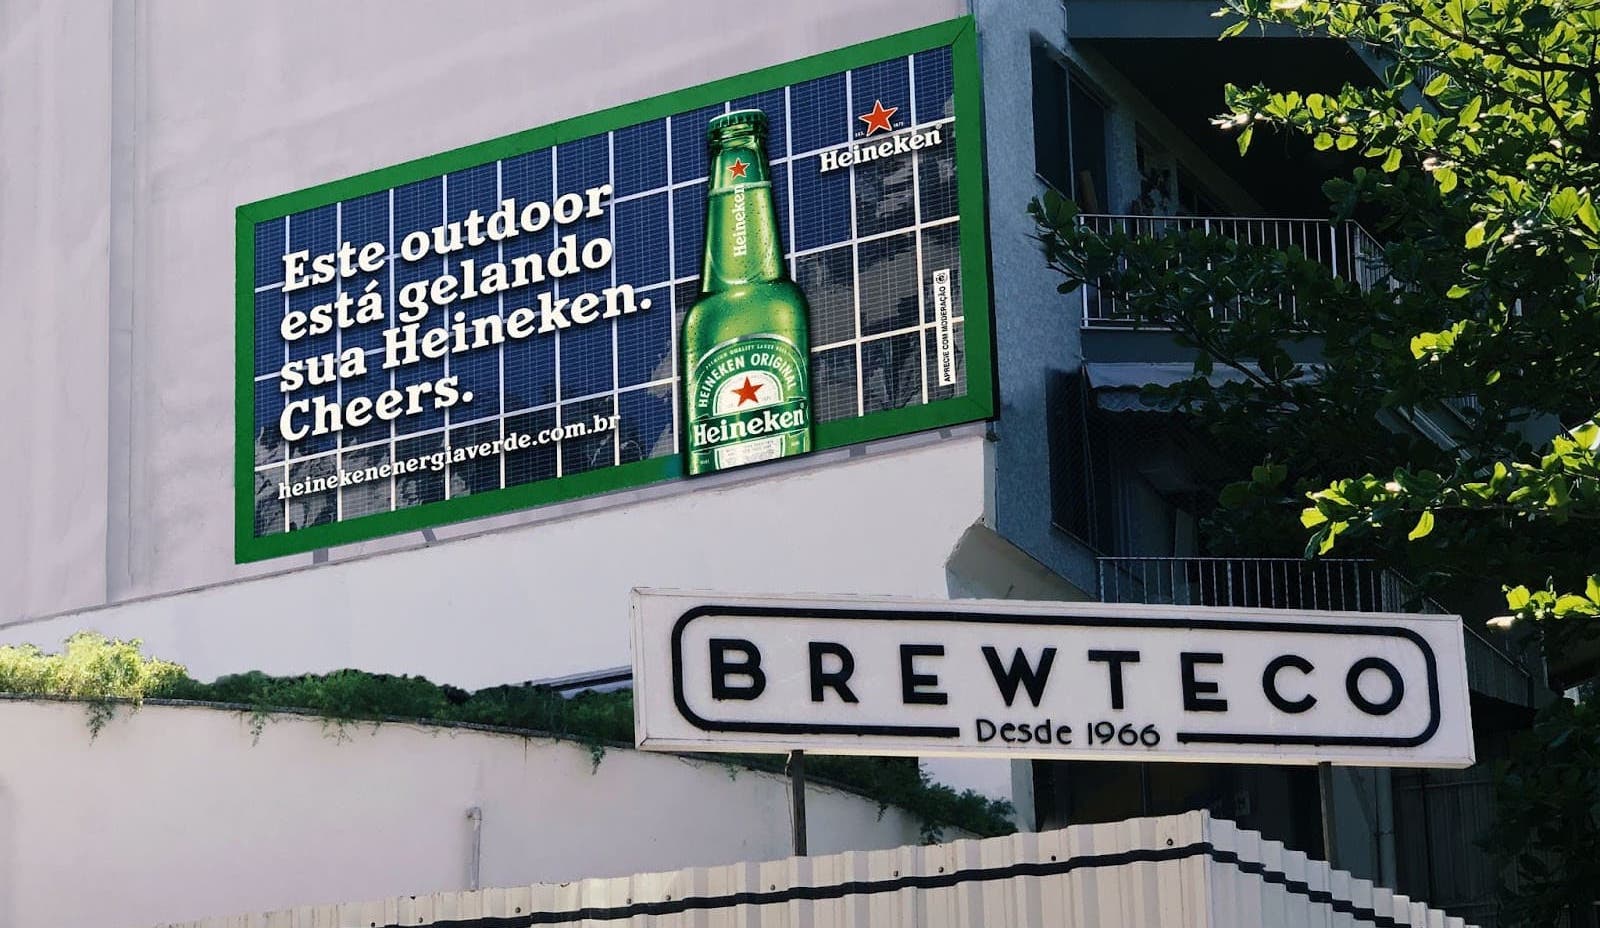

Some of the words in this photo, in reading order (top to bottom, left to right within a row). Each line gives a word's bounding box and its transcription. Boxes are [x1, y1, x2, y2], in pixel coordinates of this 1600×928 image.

[819, 129, 943, 173] Heineken
[281, 241, 386, 293] Este
[400, 183, 613, 263] outdoor
[733, 184, 746, 257] Heineken
[280, 279, 385, 341] está
[398, 233, 613, 323] gelando
[938, 286, 948, 332] MODERAÇÃO
[279, 345, 367, 392] sua
[382, 282, 652, 370] Heineken.
[942, 351, 951, 382] APRECIE
[278, 373, 474, 442] Cheers.
[698, 355, 745, 408] HEINEKEN
[277, 415, 621, 500] heinekenenergiaverde.com.br
[693, 409, 805, 447] Heineken
[708, 637, 1406, 717] BREWTECO
[975, 718, 1073, 745] Desde
[1087, 721, 1161, 747] 1966
